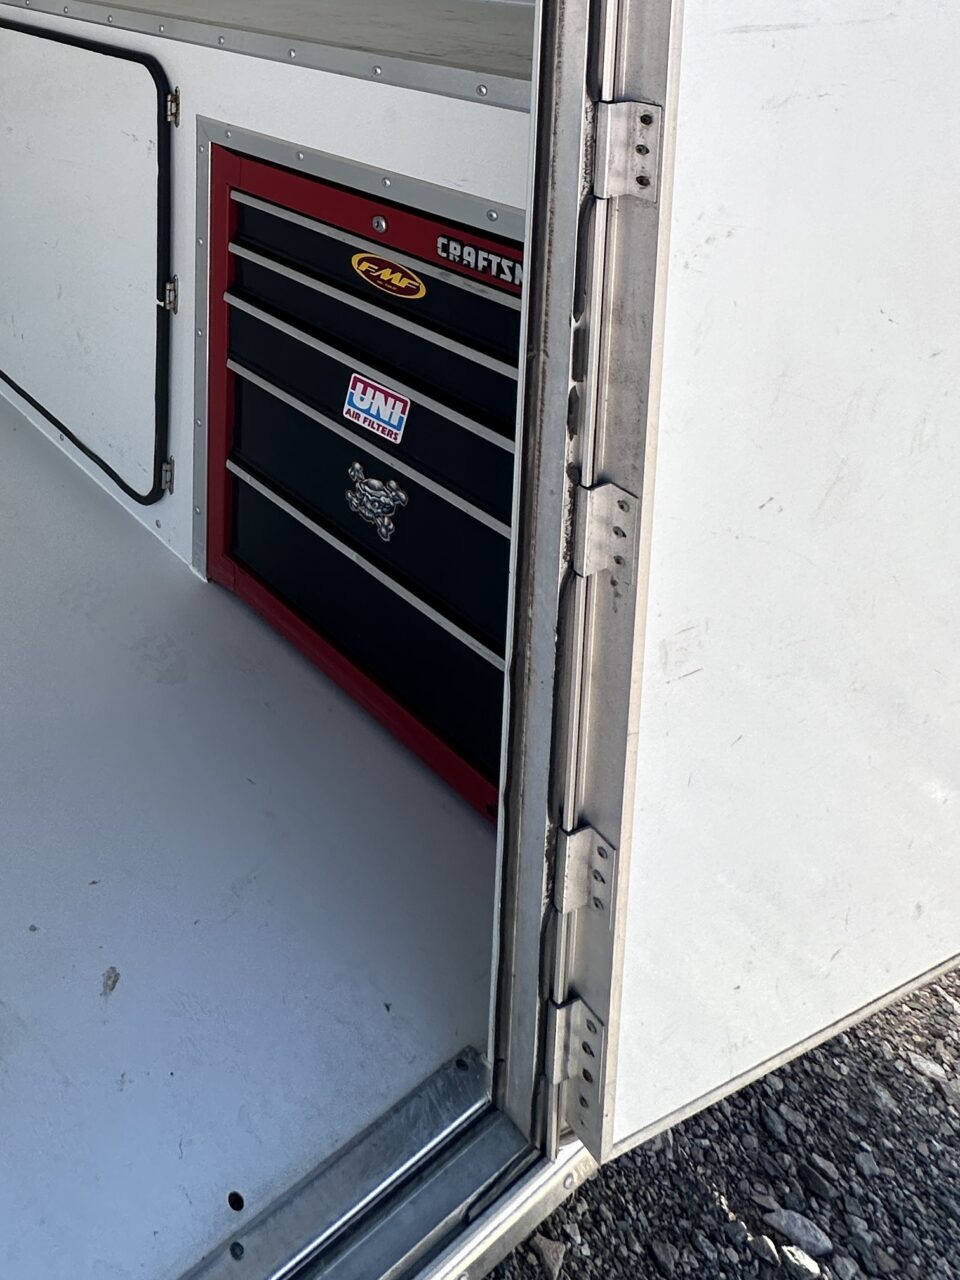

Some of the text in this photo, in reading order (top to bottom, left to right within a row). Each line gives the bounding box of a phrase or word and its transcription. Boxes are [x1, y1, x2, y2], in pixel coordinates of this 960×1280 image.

[358, 261, 420, 288] FMF
[353, 381, 404, 427] UNI
[345, 408, 399, 441] AIR FILTERS
